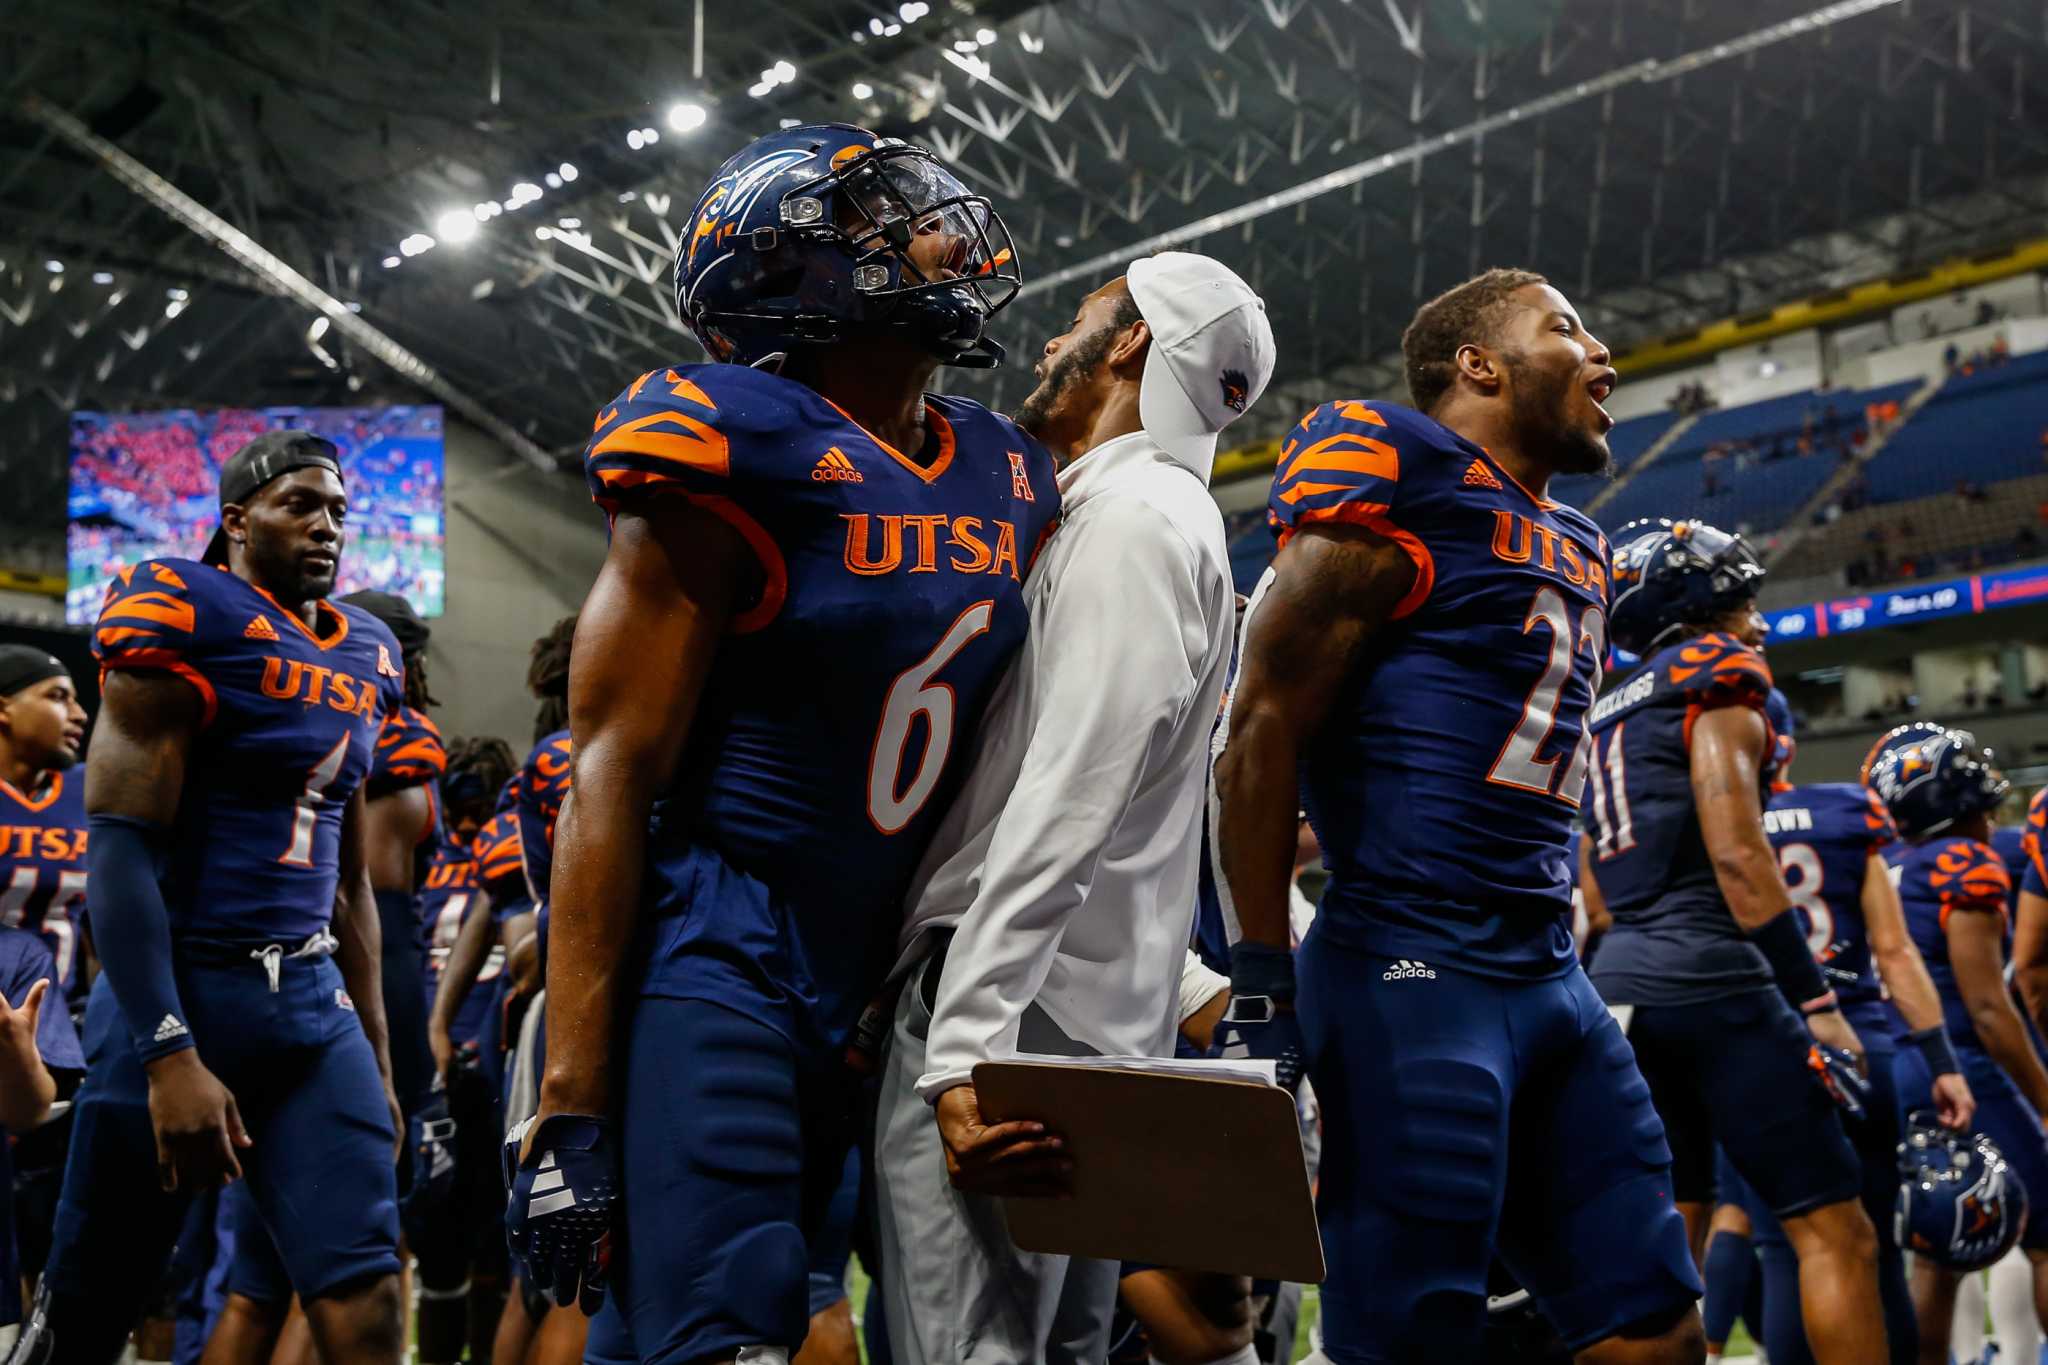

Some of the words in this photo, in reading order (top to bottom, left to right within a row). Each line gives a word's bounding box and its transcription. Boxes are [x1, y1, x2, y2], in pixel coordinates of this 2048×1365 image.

[811, 467, 864, 484] adidas
[838, 513, 1021, 582] UTSA
[1491, 510, 1609, 606] UTSA
[260, 655, 378, 726] UTSA
[866, 599, 994, 835] 6
[278, 729, 351, 868] 1
[1589, 720, 1637, 862] 11
[1762, 808, 1812, 834] OWN
[1383, 966, 1437, 981] adidas
